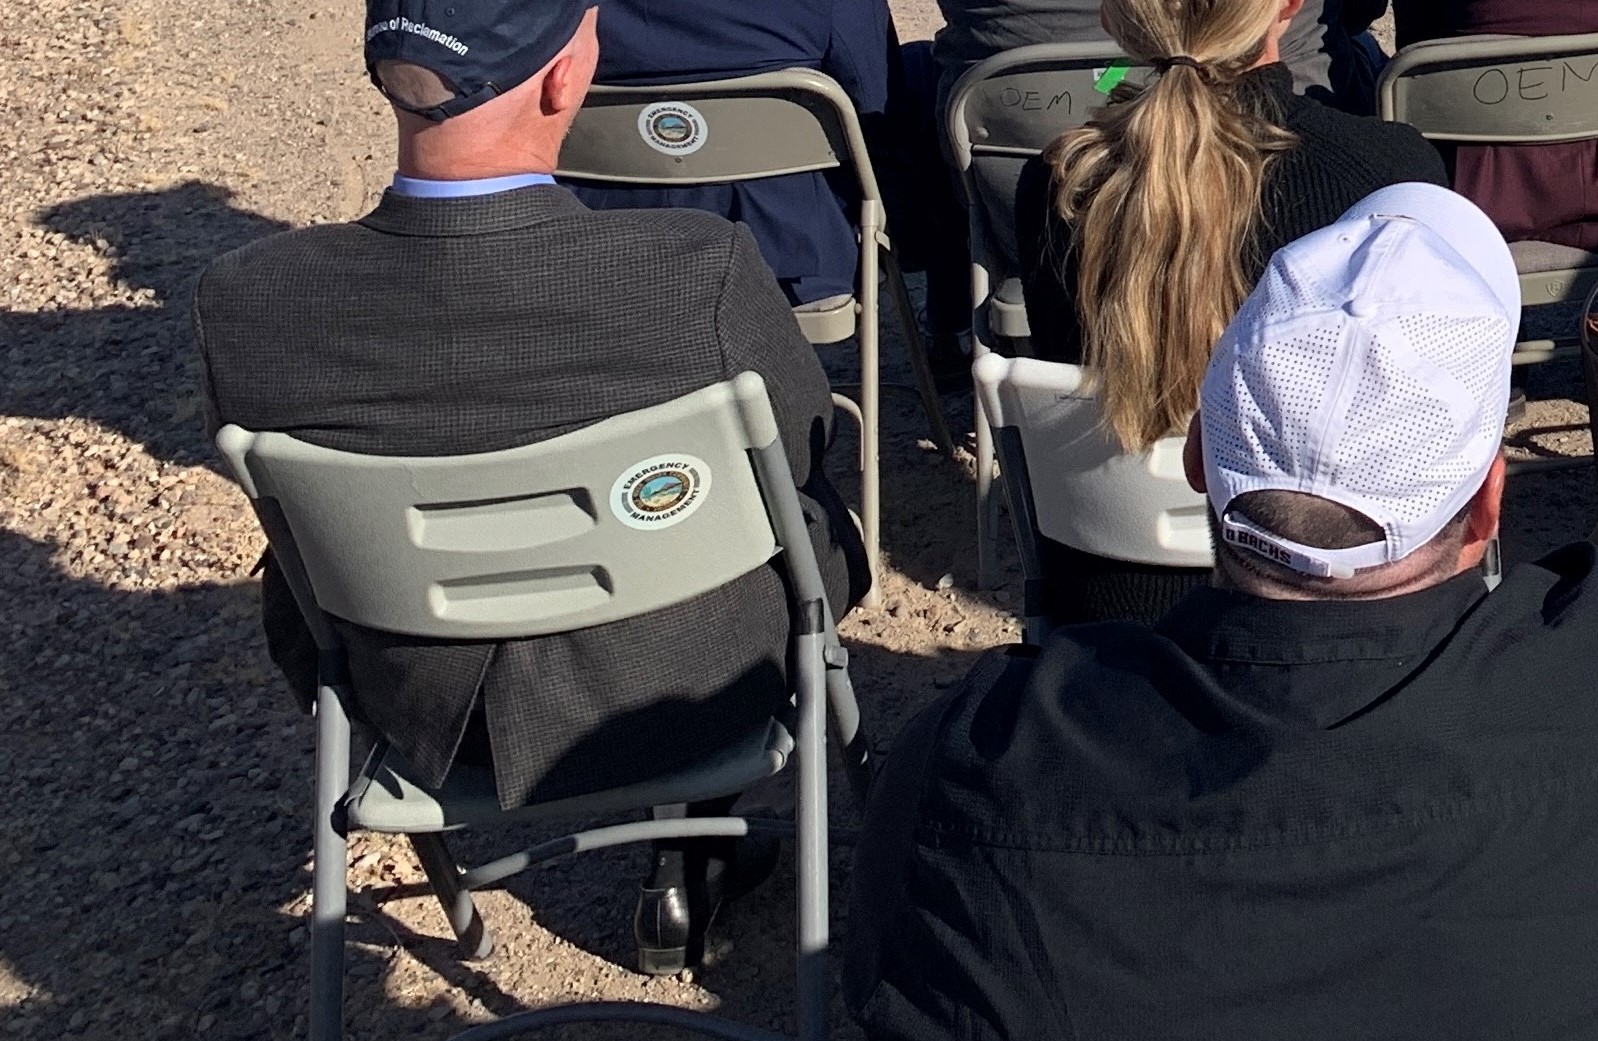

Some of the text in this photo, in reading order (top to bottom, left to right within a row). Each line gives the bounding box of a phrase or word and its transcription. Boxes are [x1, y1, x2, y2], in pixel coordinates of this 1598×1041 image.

[389, 17, 400, 31] of
[400, 17, 469, 56] Reclamation
[647, 107, 694, 118] EMERGENCY
[1000, 87, 1072, 115] OEM
[623, 462, 690, 490] EMERGENCY
[630, 490, 700, 522] MANAGEMENT
